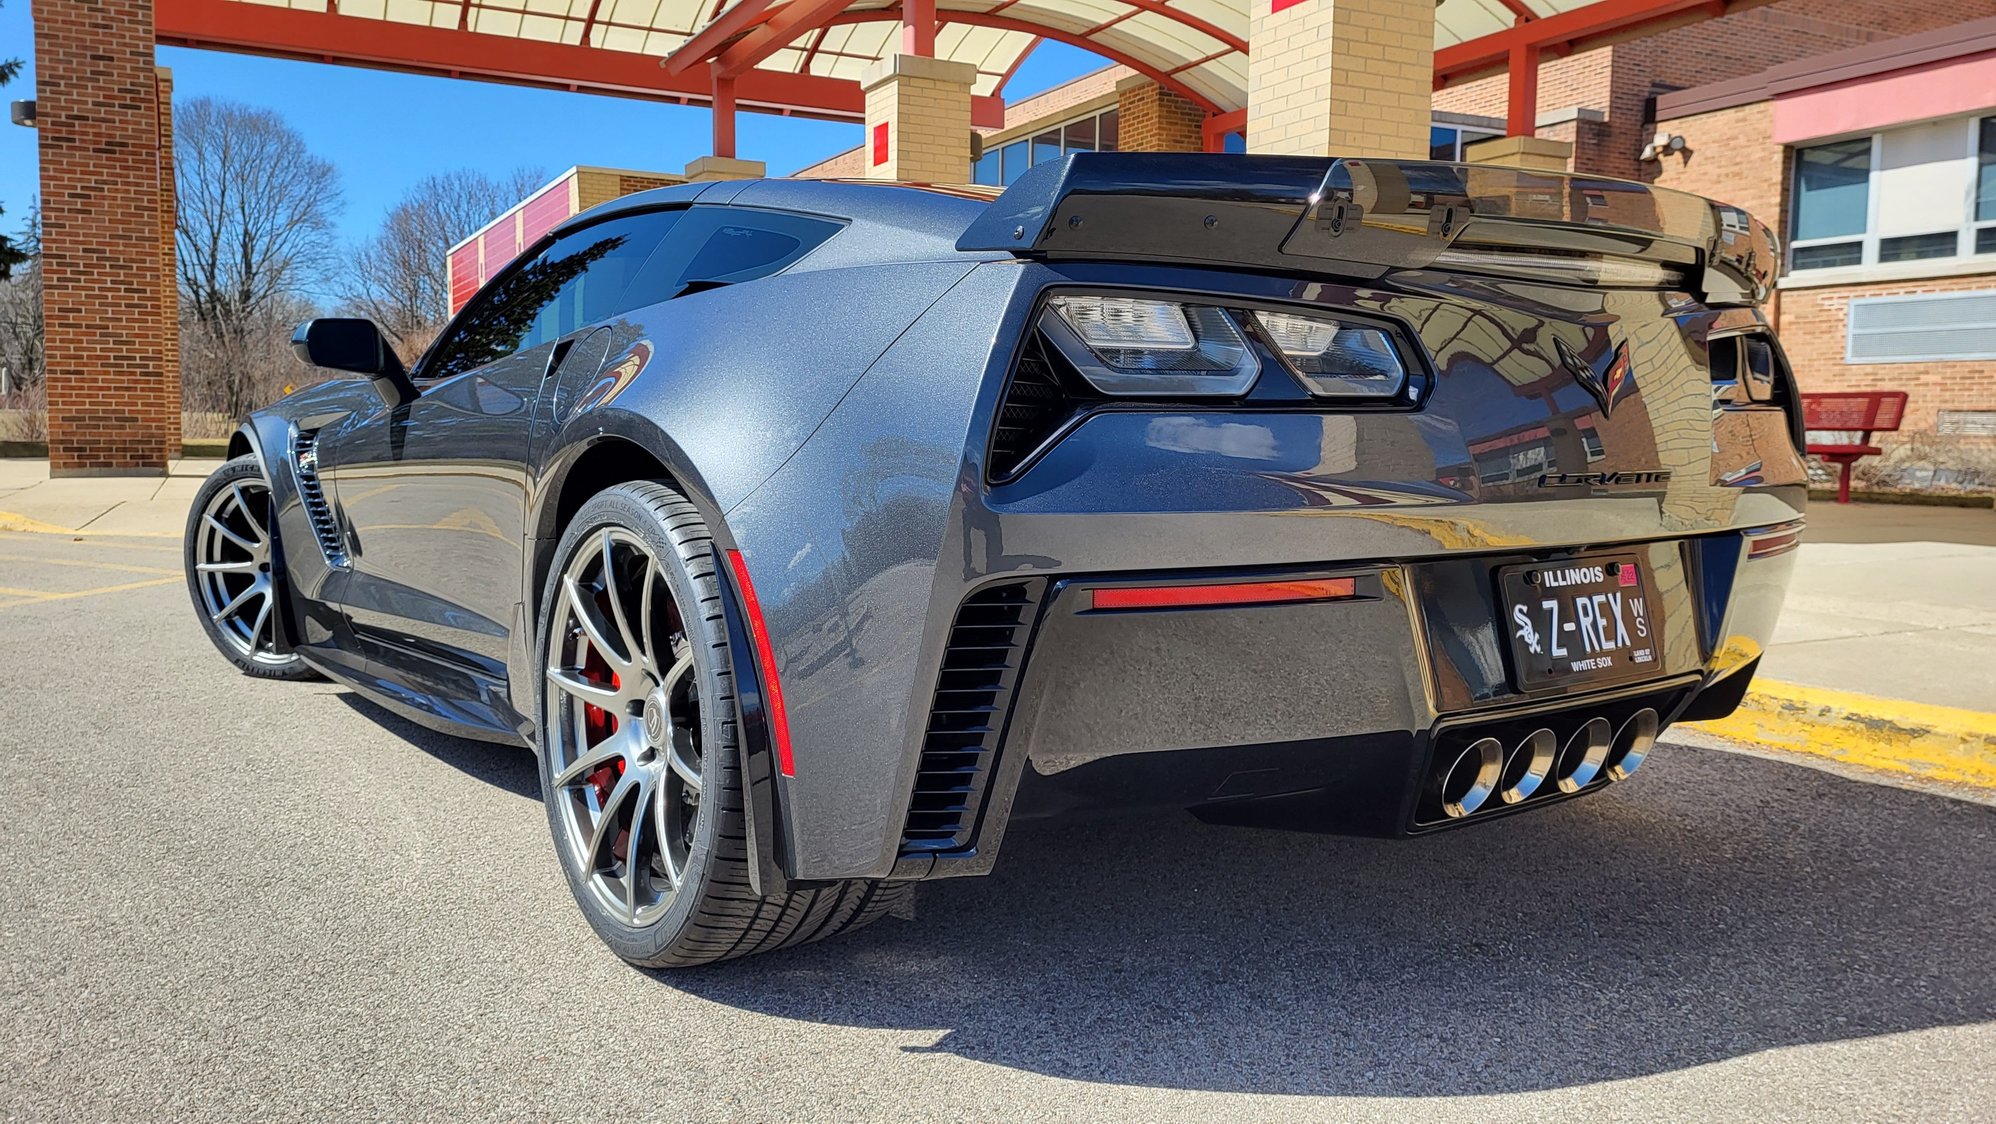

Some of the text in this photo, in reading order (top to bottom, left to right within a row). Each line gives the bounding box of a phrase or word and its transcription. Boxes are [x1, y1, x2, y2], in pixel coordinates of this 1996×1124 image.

[619, 503, 643, 522] SEASON
[1543, 566, 1604, 588] ILLINOIS
[1629, 597, 1644, 618] W
[1542, 590, 1631, 658] Z-REX
[1635, 618, 1647, 638] S
[1571, 655, 1613, 673] WHITE SOX
